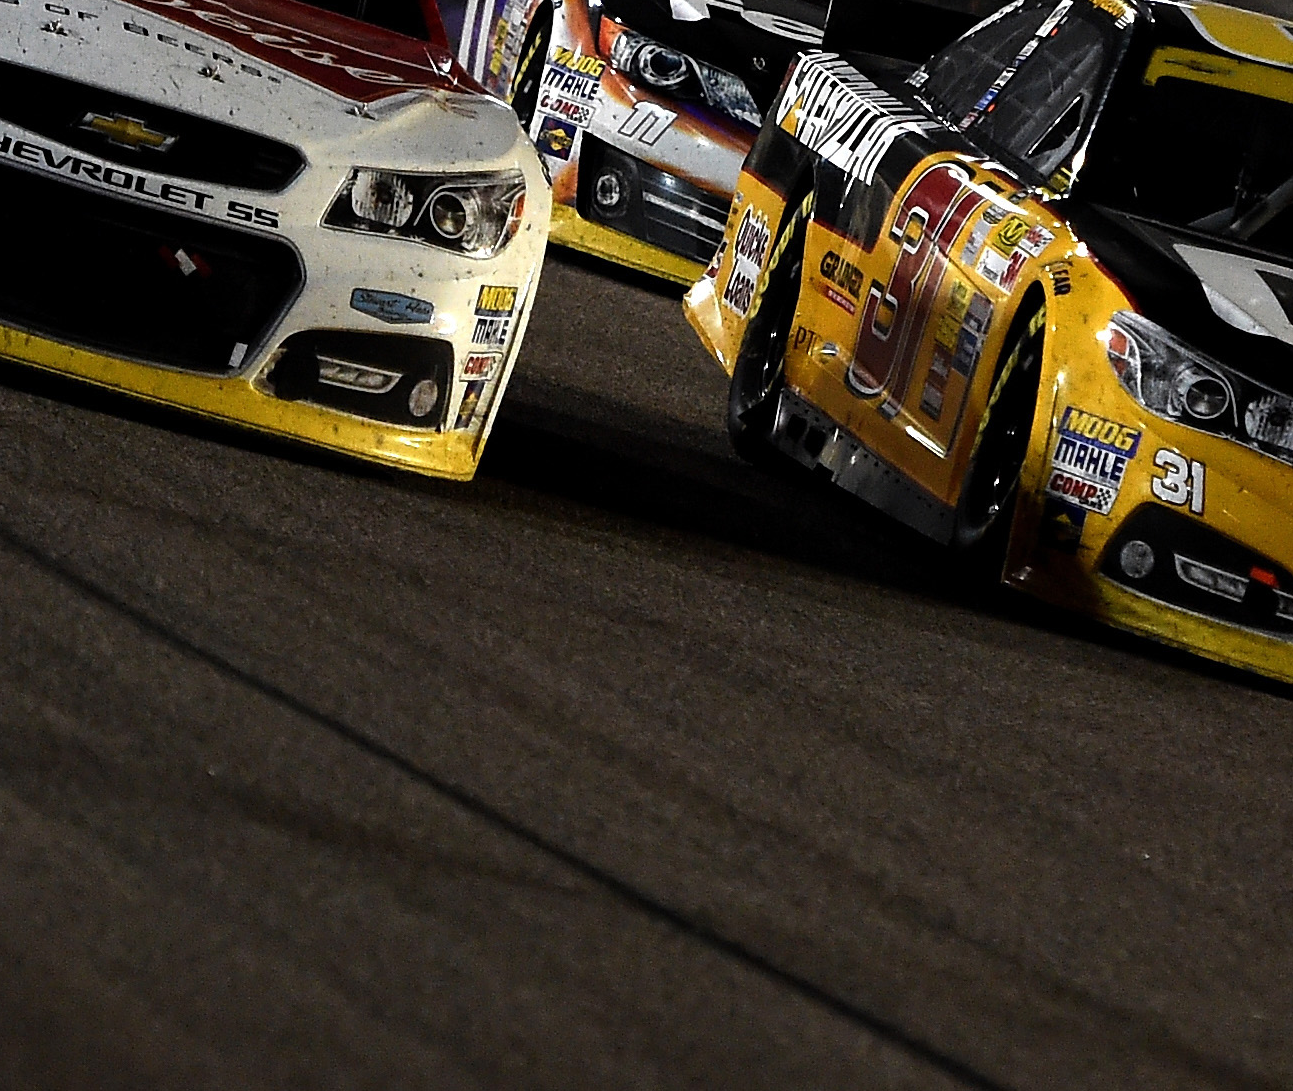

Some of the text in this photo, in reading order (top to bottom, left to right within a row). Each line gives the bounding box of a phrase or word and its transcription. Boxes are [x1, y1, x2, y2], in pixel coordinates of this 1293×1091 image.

[44, 3, 99, 21] OF
[552, 46, 606, 77] MOOG
[543, 67, 600, 101] MAHLE
[617, 100, 679, 147] 11
[226, 200, 280, 230] SS
[1066, 409, 1139, 452] MOOG
[1054, 437, 1127, 482] MAHLE
[1050, 473, 1099, 500] COMP
[1151, 447, 1206, 516] 31
